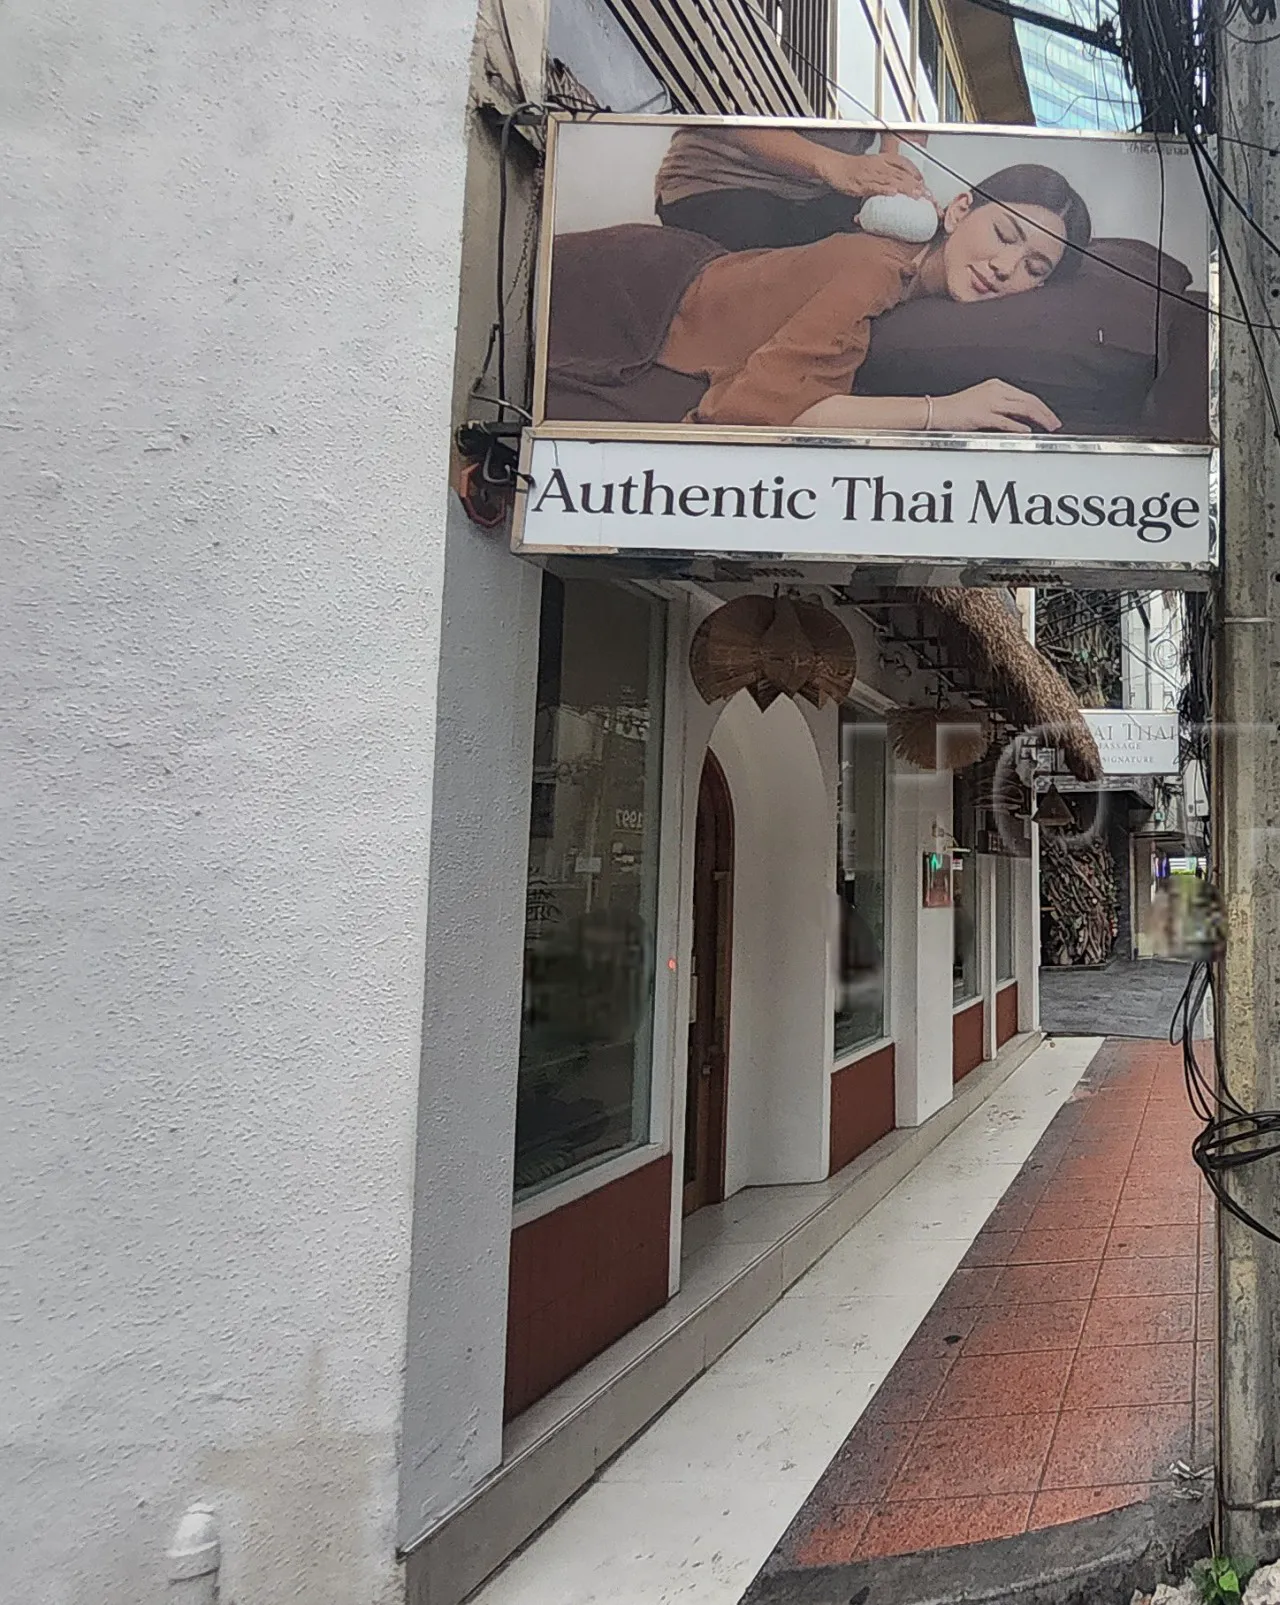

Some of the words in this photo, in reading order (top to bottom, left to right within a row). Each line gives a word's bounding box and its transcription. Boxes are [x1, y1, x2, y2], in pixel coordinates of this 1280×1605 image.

[531, 468, 817, 520] Authentic
[831, 476, 954, 524] Thai
[968, 479, 1200, 543] Massage
[1094, 725, 1113, 741] AI
[1122, 723, 1175, 741] THAI
[1102, 755, 1154, 764] SIGNATURE
